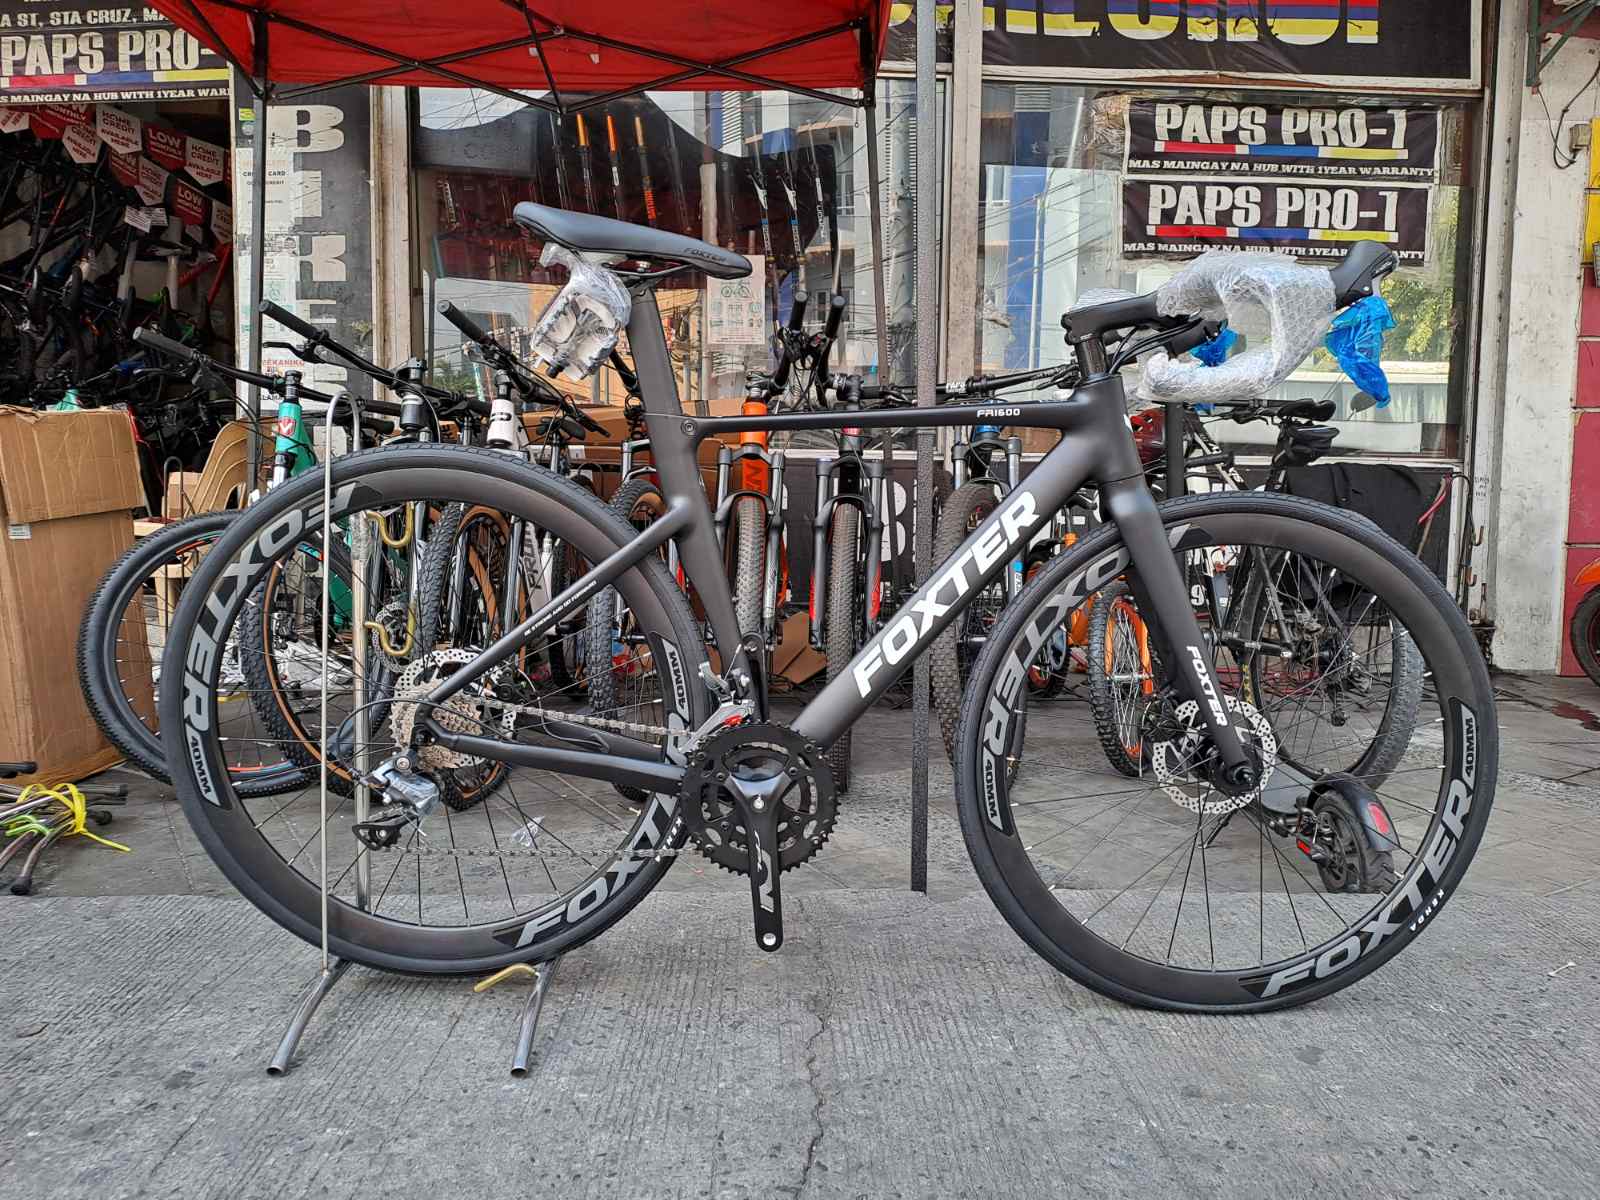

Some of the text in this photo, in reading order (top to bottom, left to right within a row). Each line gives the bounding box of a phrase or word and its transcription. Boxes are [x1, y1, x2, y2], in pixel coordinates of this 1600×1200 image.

[49, 11, 82, 26] STA
[0, 31, 104, 76] PAPS
[11, 94, 71, 103] MAINGAY
[72, 93, 92, 102] NA
[93, 92, 119, 100] HUB
[120, 91, 154, 99] WITH
[157, 89, 196, 98] 1YEAR
[1154, 103, 1267, 145] PAPS
[1128, 159, 1435, 177] MAS MAINGAY NA HUB WITH 1YEAR WARRANTY
[1149, 184, 1261, 228] PAPS
[1124, 242, 1156, 251] MAS
[1158, 243, 1220, 252] MAINGAY
[1222, 244, 1241, 252] NA
[1273, 246, 1306, 256] WITH
[184, 482, 355, 732] FOXTER
[852, 491, 1040, 698] FOXTER
[668, 652, 687, 710] 40MM
[1186, 645, 1228, 726] FOXTER
[190, 735, 212, 796] 40MM
[1465, 717, 1474, 778] 40MM
[983, 757, 997, 819] 40MM
[1261, 778, 1475, 998] FOXTER
[1410, 888, 1445, 932] KENDA
